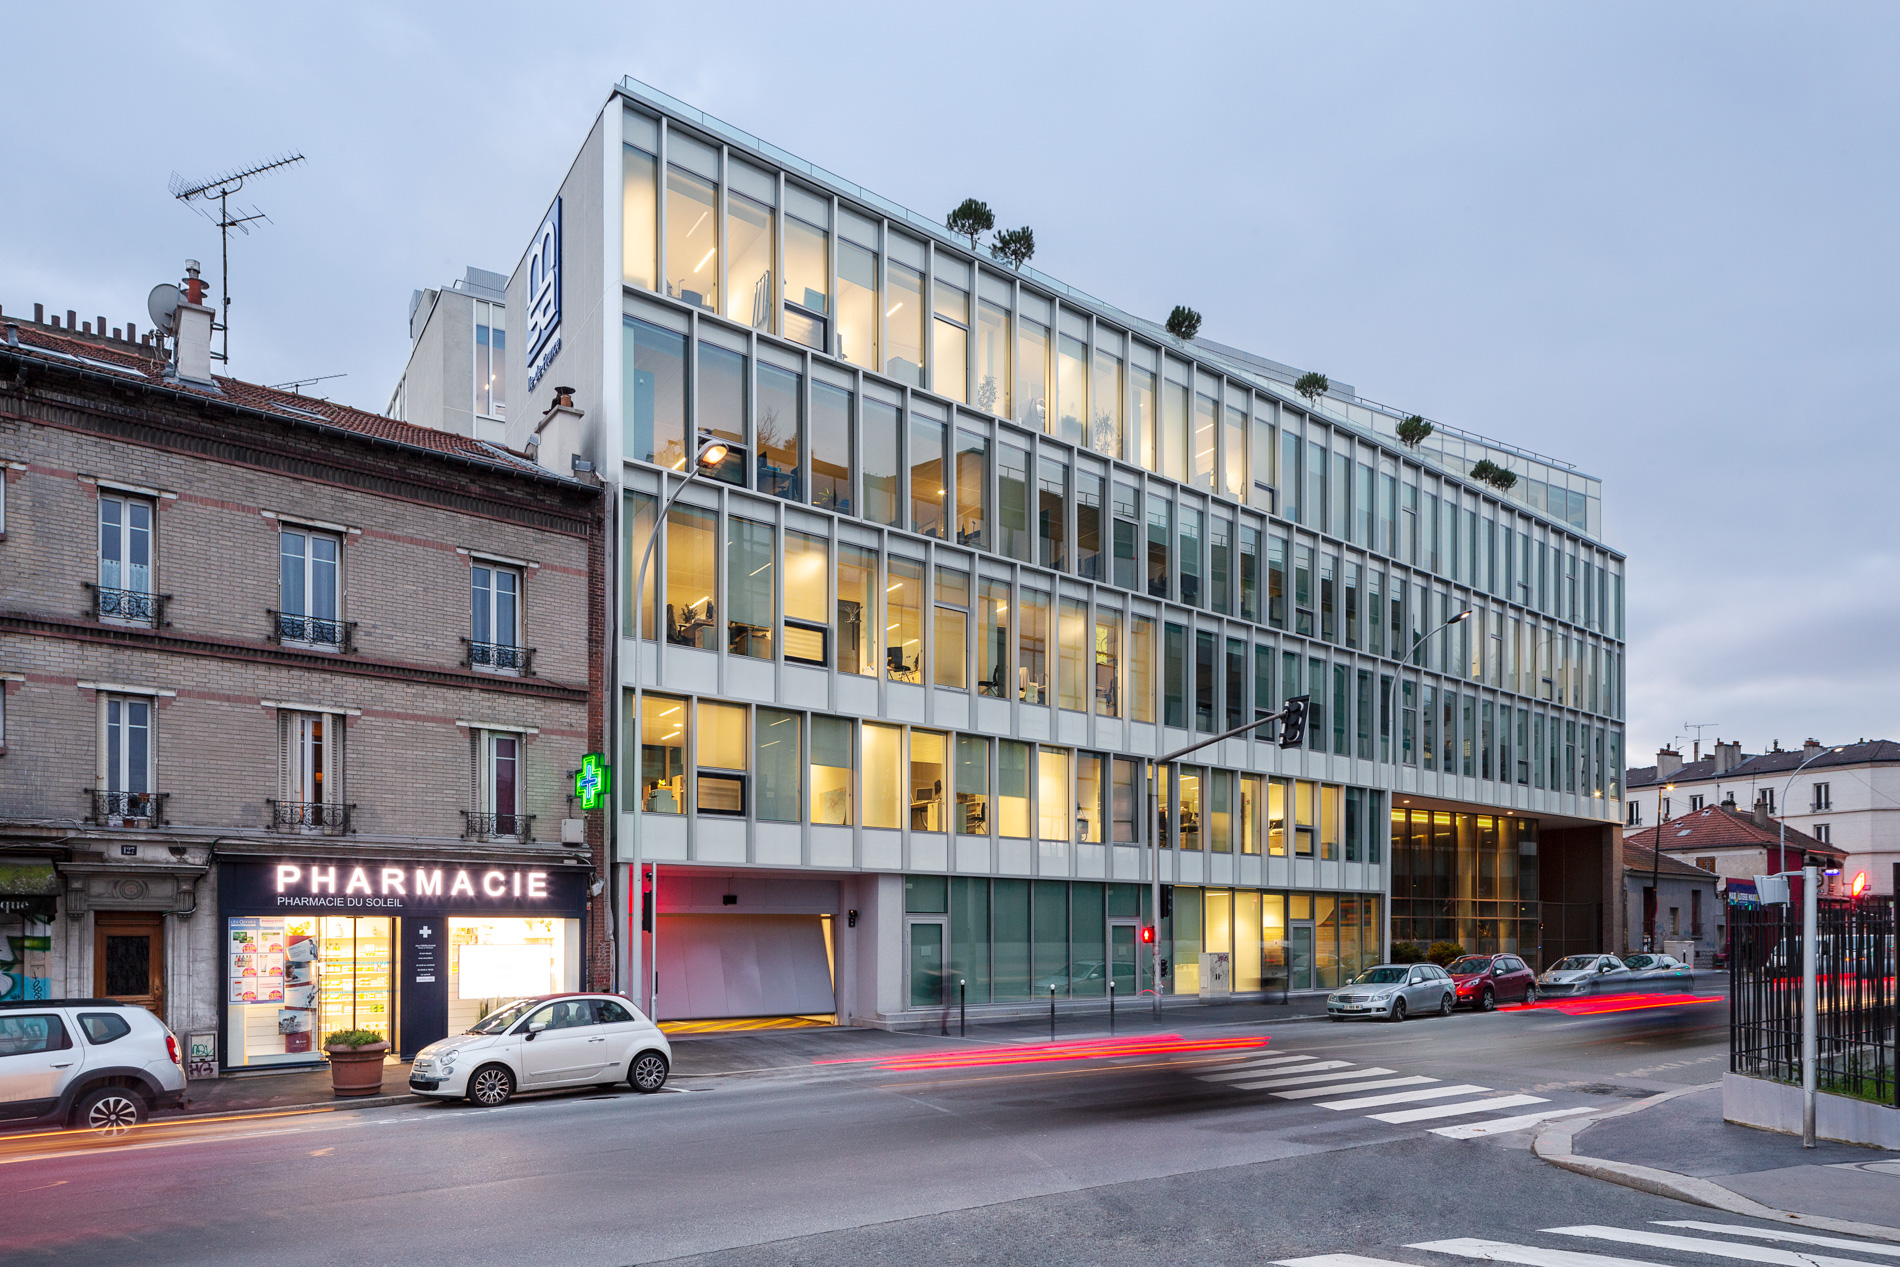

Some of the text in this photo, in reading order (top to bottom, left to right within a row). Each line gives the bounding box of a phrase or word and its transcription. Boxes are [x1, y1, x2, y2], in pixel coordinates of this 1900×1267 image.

[123, 846, 135, 854] 127
[277, 865, 547, 897] PHARMACIE
[0, 901, 29, 913] que
[277, 897, 403, 908] PHARMACIE DU SOLEIL
